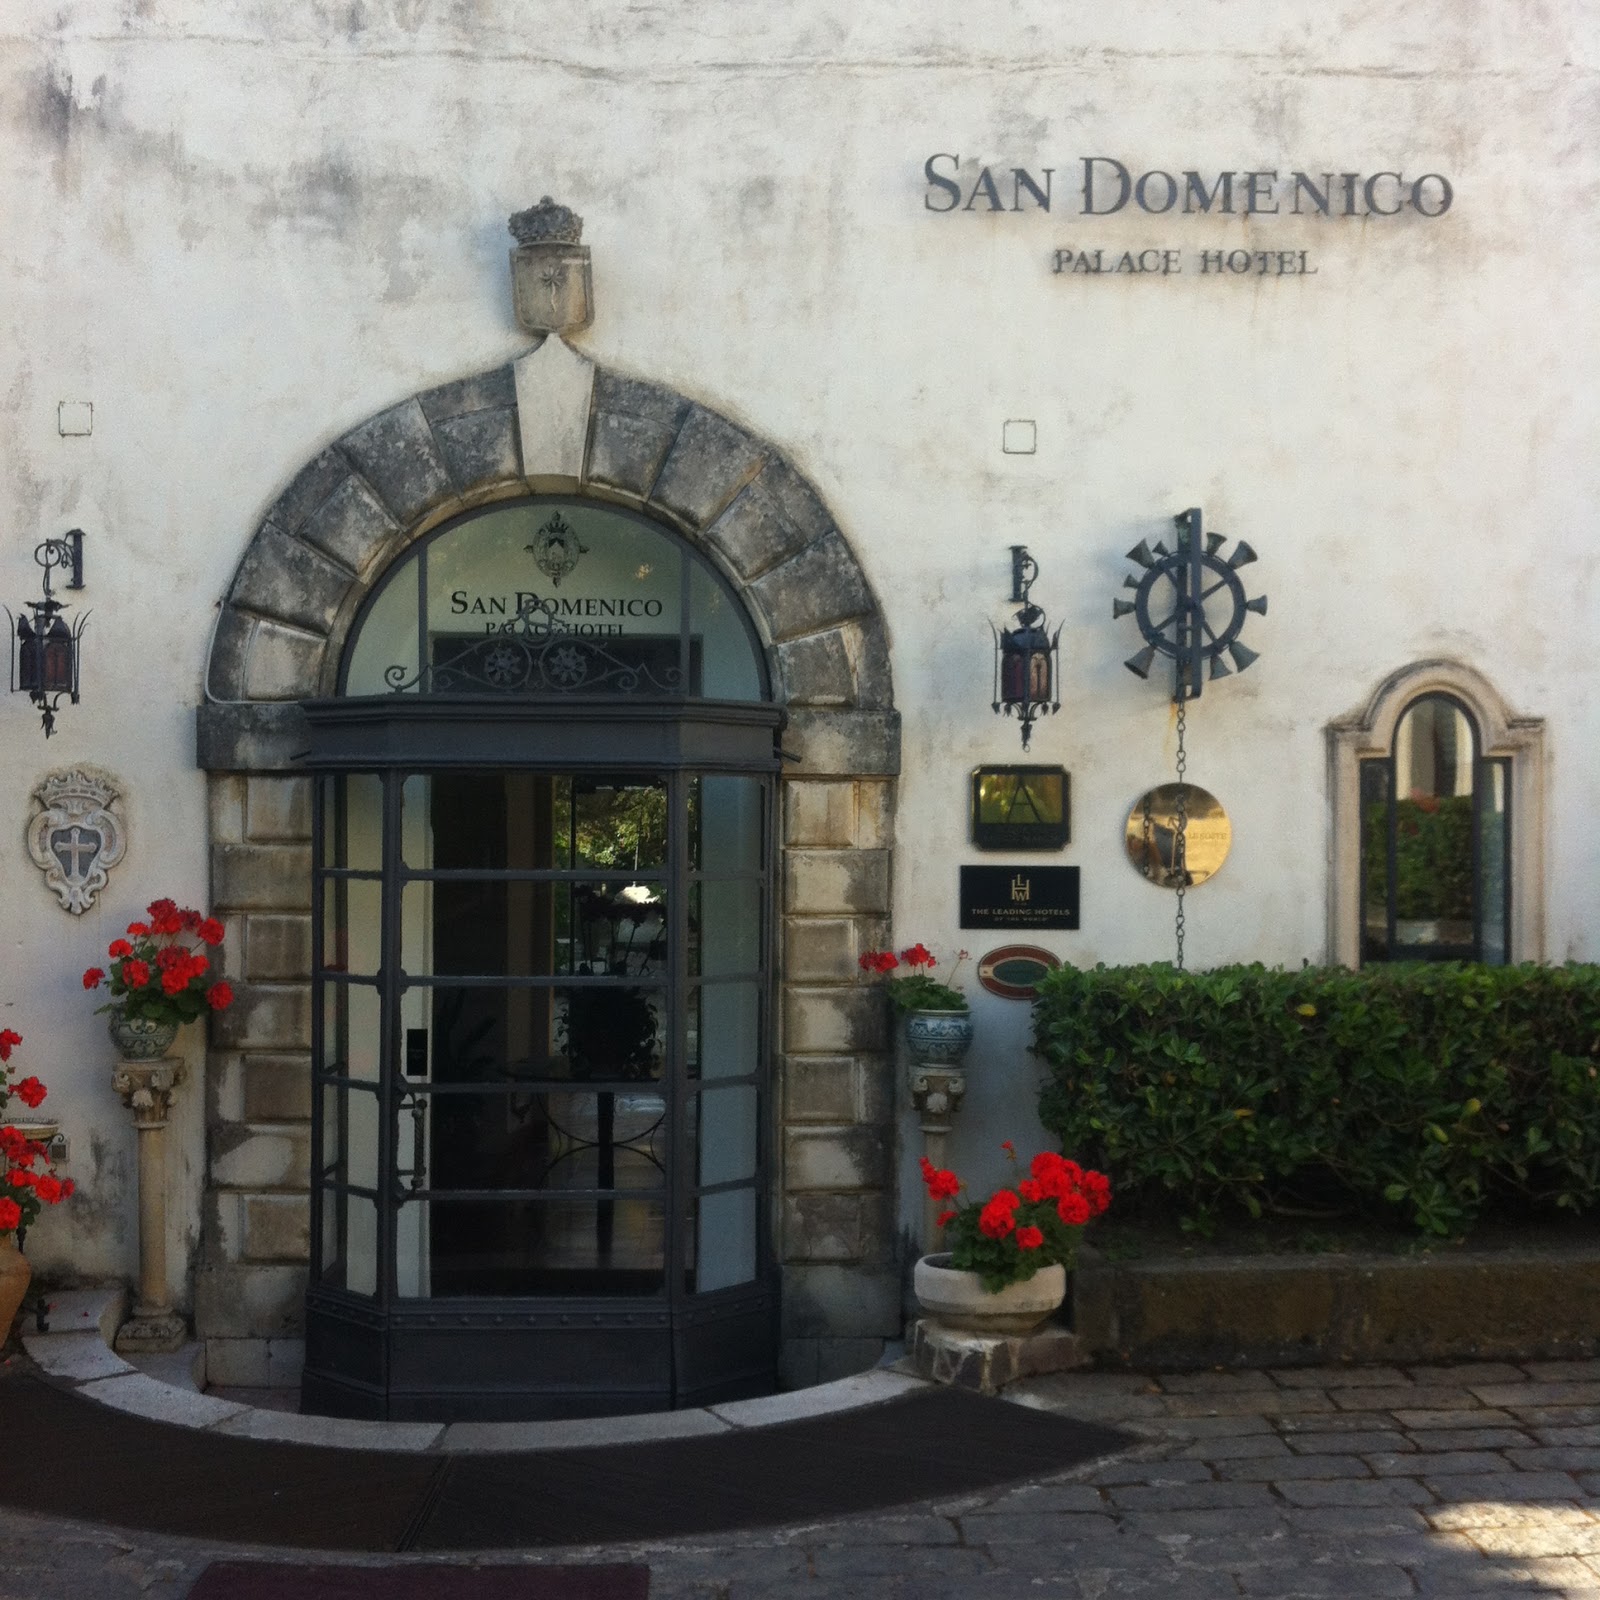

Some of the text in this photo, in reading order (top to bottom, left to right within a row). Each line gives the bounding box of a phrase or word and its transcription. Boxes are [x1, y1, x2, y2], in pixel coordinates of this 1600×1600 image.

[923, 153, 1454, 217] SAN DOMENICO
[1052, 248, 1318, 276] PALACE HOTEL
[451, 590, 663, 617] SAN DOMENICO
[485, 622, 560, 636] PALAC
